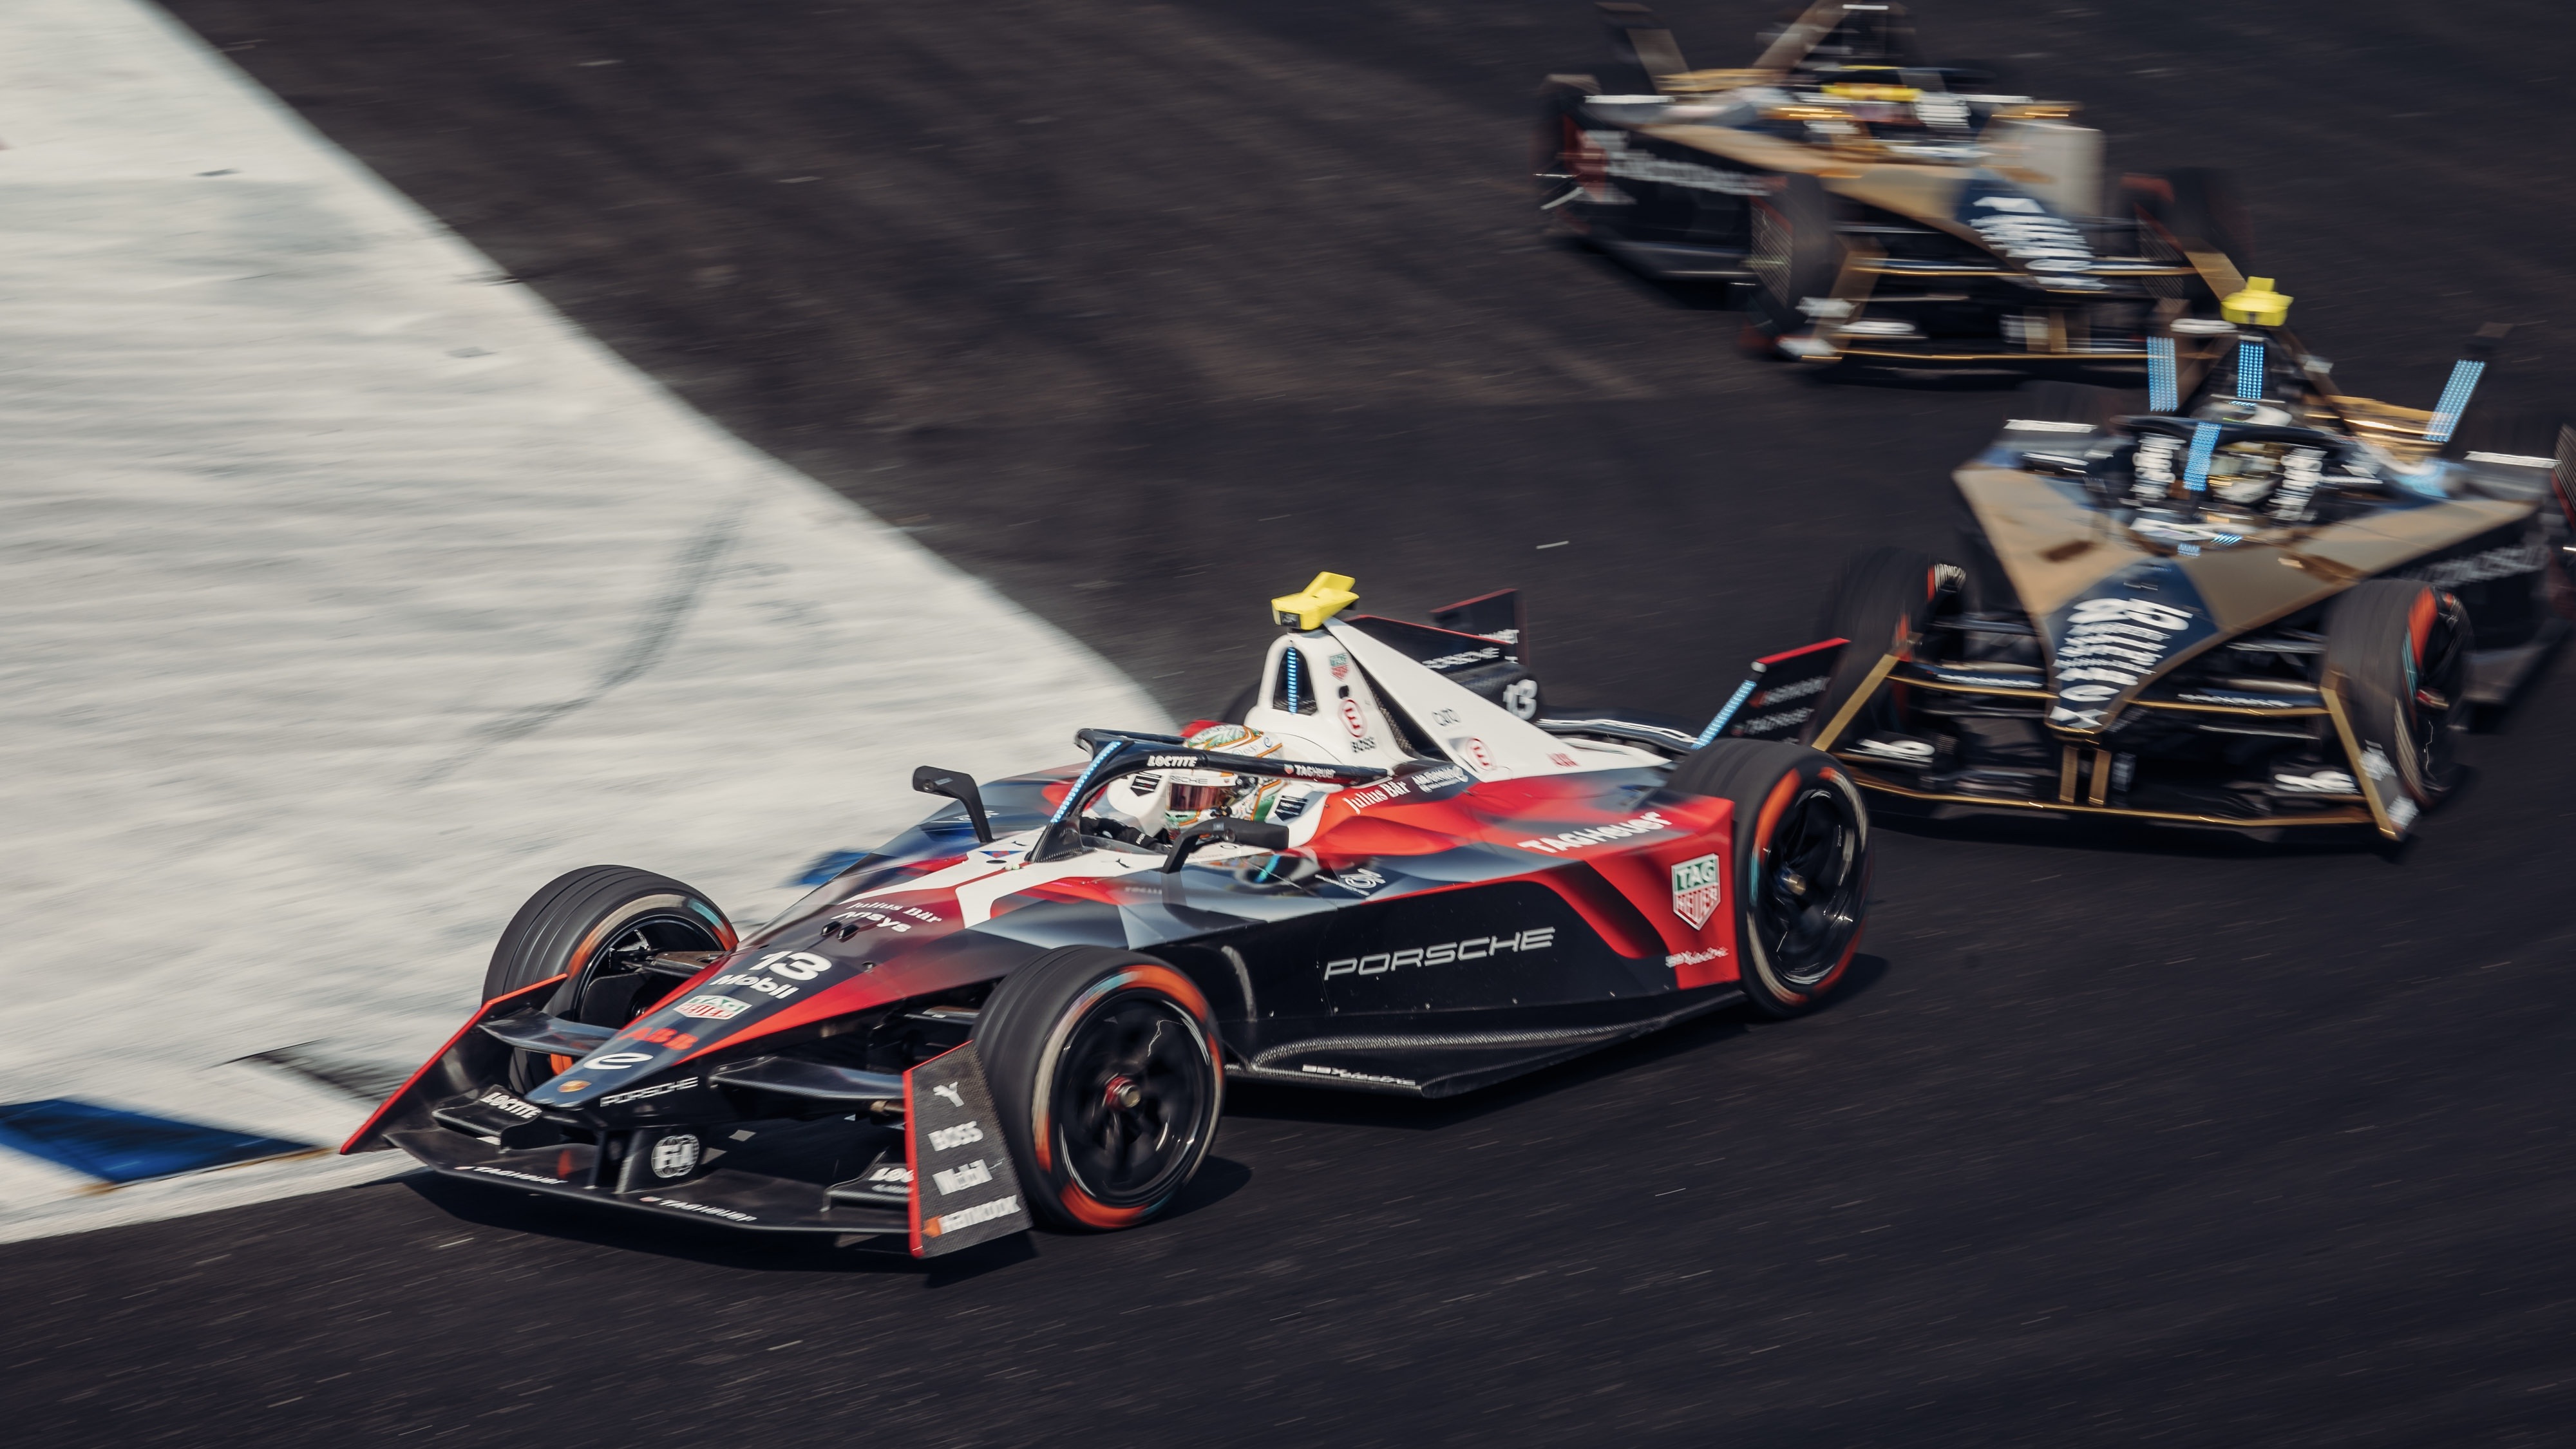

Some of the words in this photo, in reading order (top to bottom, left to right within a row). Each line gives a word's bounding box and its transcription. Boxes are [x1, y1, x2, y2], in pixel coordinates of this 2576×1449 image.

[1503, 679, 1538, 721] 13
[1146, 755, 1198, 768] LOCTITE
[1341, 786, 1387, 815] Julius
[1676, 860, 1716, 889] TAG
[845, 901, 903, 912] Julius
[748, 950, 833, 981] 13
[1324, 926, 1555, 981] PORSCHE
[708, 974, 800, 999] Mobil
[616, 1027, 699, 1051] ABB
[479, 1092, 543, 1119] LOCTITE
[600, 1076, 699, 1107] PORSCHE
